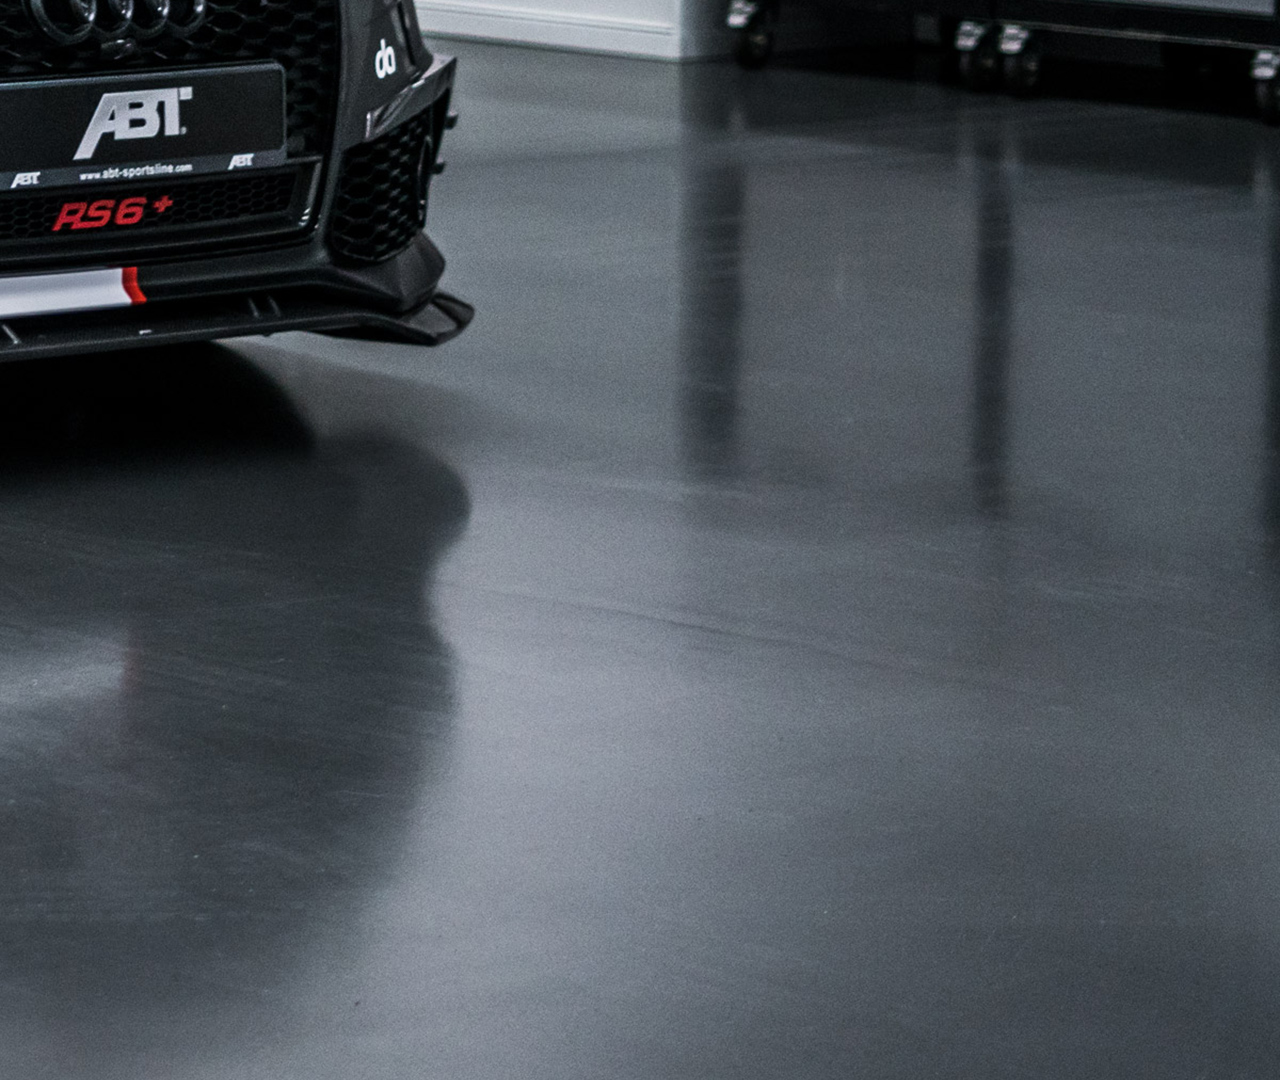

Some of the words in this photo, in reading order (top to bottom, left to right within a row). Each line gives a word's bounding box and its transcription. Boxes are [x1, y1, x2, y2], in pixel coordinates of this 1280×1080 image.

[228, 153, 255, 170] ABT
[10, 172, 41, 188] ABT
[79, 163, 193, 181] www.abt-sportsline.com
